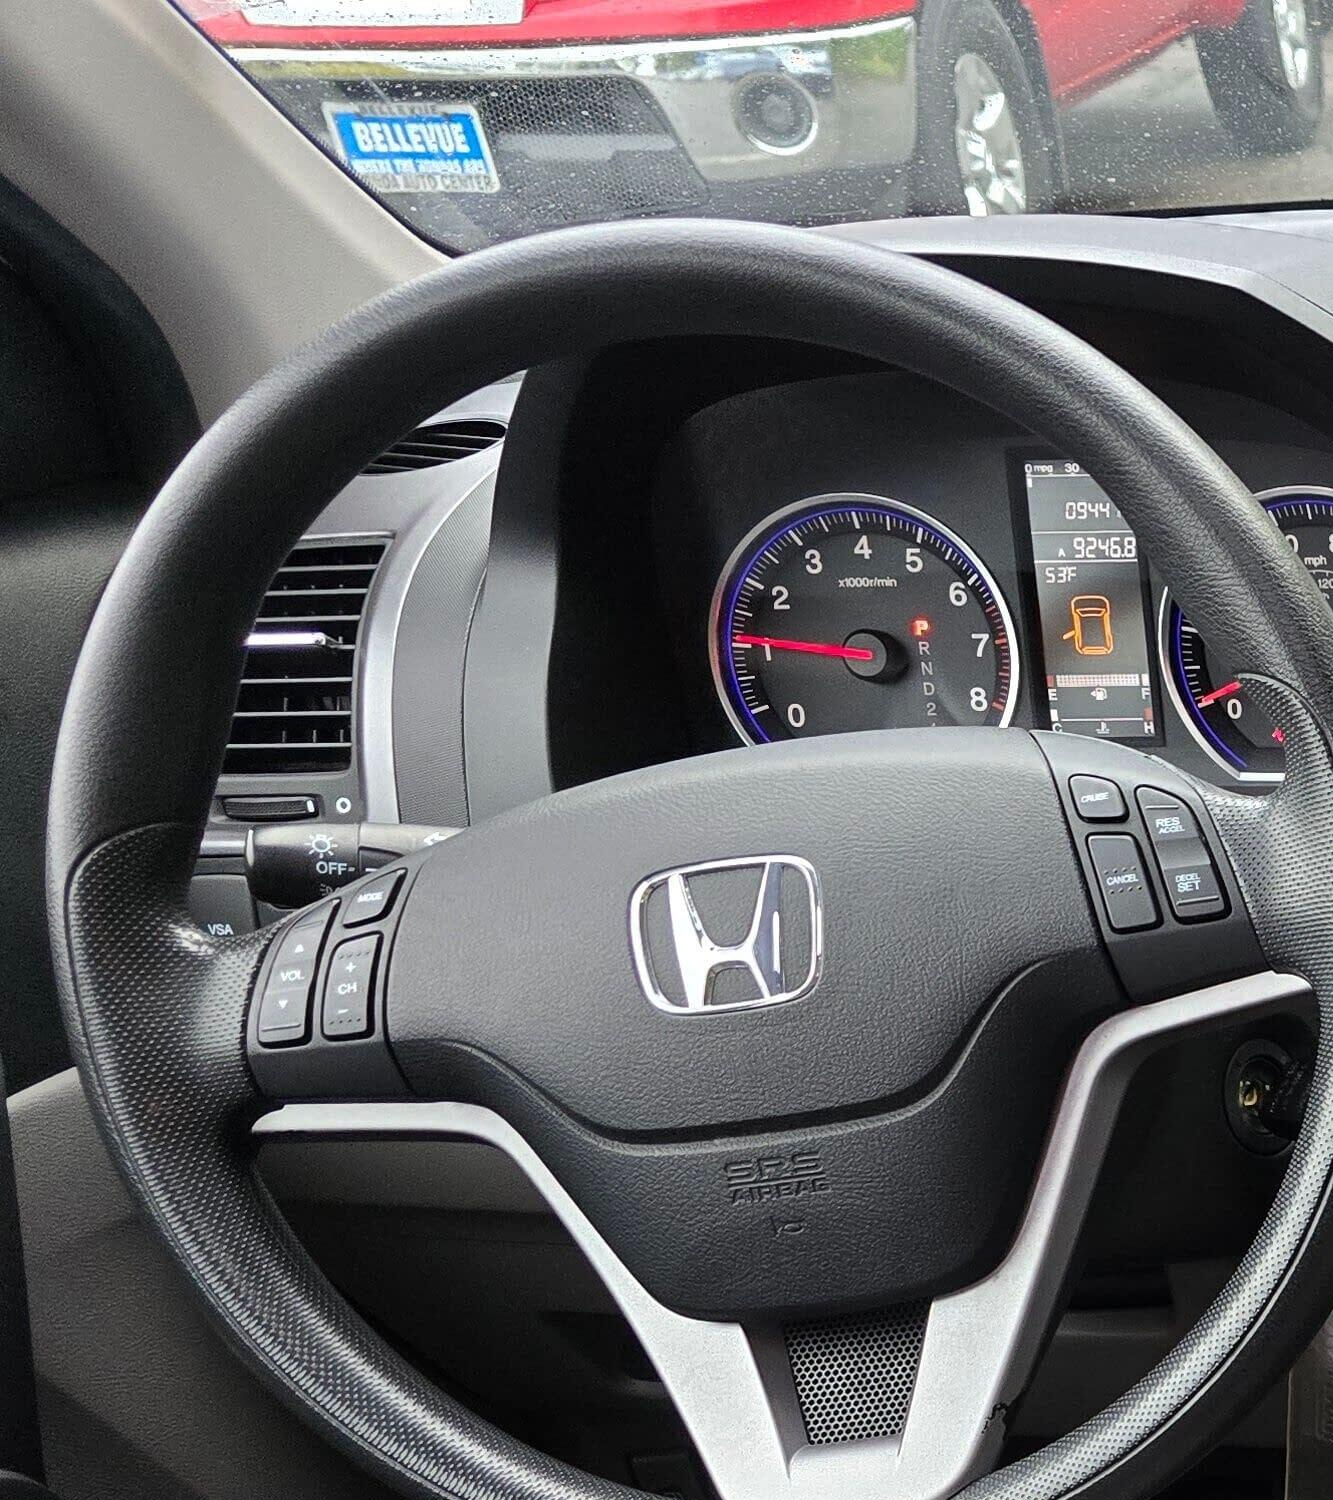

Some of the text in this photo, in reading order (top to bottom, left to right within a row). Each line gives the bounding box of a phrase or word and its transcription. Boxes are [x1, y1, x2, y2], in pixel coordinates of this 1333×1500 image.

[351, 121, 471, 153] BELLEVUE
[1064, 462, 1080, 473] 30
[853, 535, 873, 560] 4
[1073, 536, 1136, 559] 9246.8
[805, 549, 824, 575] 3
[905, 548, 924, 573] 5
[1304, 554, 1328, 568] mph
[771, 585, 791, 610] 2
[949, 582, 968, 606] 6
[914, 620, 929, 635] P
[918, 640, 931, 655] R
[971, 633, 990, 658] 7
[921, 661, 934, 676] N
[923, 681, 936, 696] D
[1048, 689, 1057, 701] E
[969, 687, 989, 711] 8
[926, 702, 938, 717] 2
[1227, 698, 1243, 719] 0
[787, 704, 807, 729] 0
[1143, 722, 1155, 734] H
[1154, 816, 1182, 829] RES
[1159, 825, 1185, 834] ACCEL
[315, 861, 348, 876] OFF
[1106, 874, 1139, 886] CANCEL
[1175, 873, 1201, 883] DECEL
[1177, 881, 1202, 893] SET
[357, 891, 385, 903] MODE
[207, 923, 234, 936] VSA
[280, 970, 305, 983] VOL
[337, 983, 357, 995] CH
[724, 1151, 824, 1184] SRS
